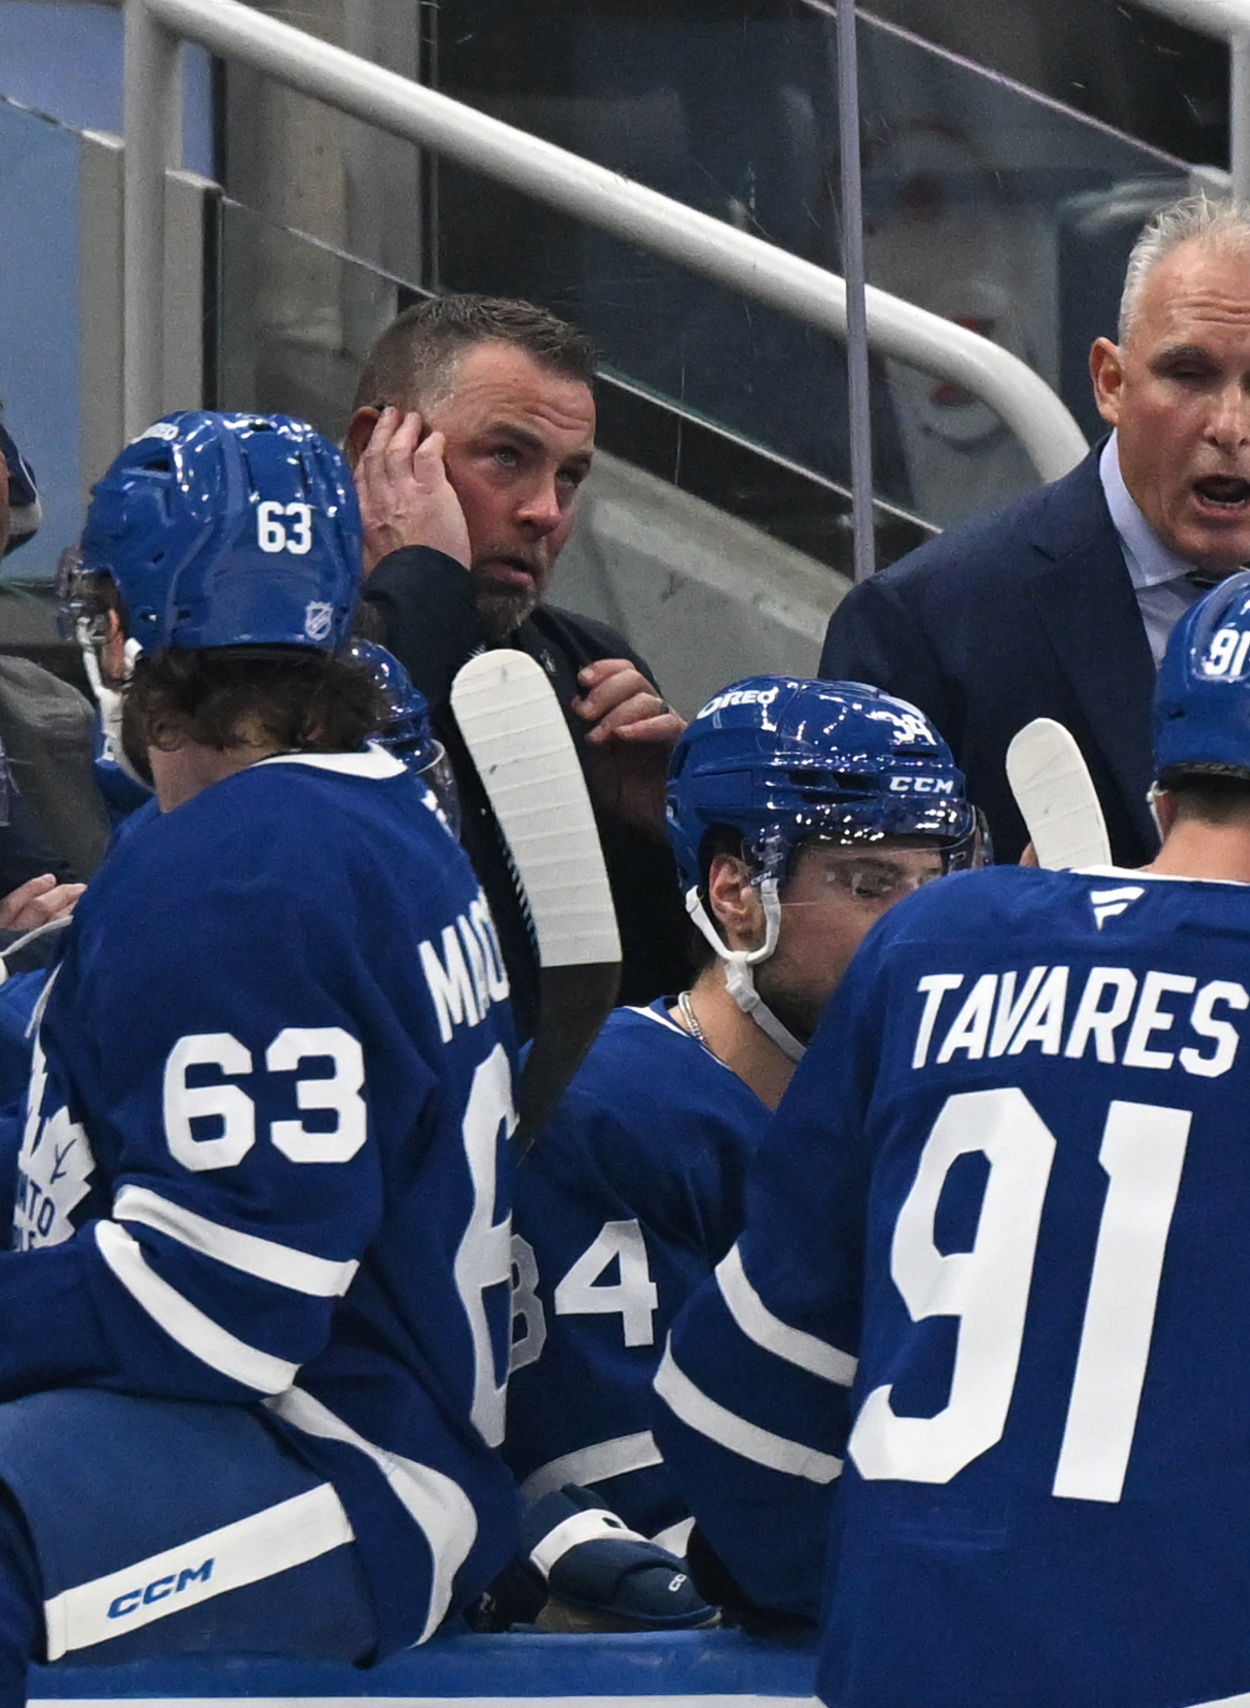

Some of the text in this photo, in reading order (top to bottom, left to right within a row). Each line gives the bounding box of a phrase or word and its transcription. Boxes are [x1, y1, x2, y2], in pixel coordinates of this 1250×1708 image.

[257, 501, 311, 554] 63
[697, 690, 776, 720] OREO
[889, 776, 954, 794] CCM
[912, 966, 1250, 1078] TAVARES
[162, 1026, 367, 1171] 63
[847, 1087, 1193, 1504] 91
[106, 1557, 216, 1619] CCM
